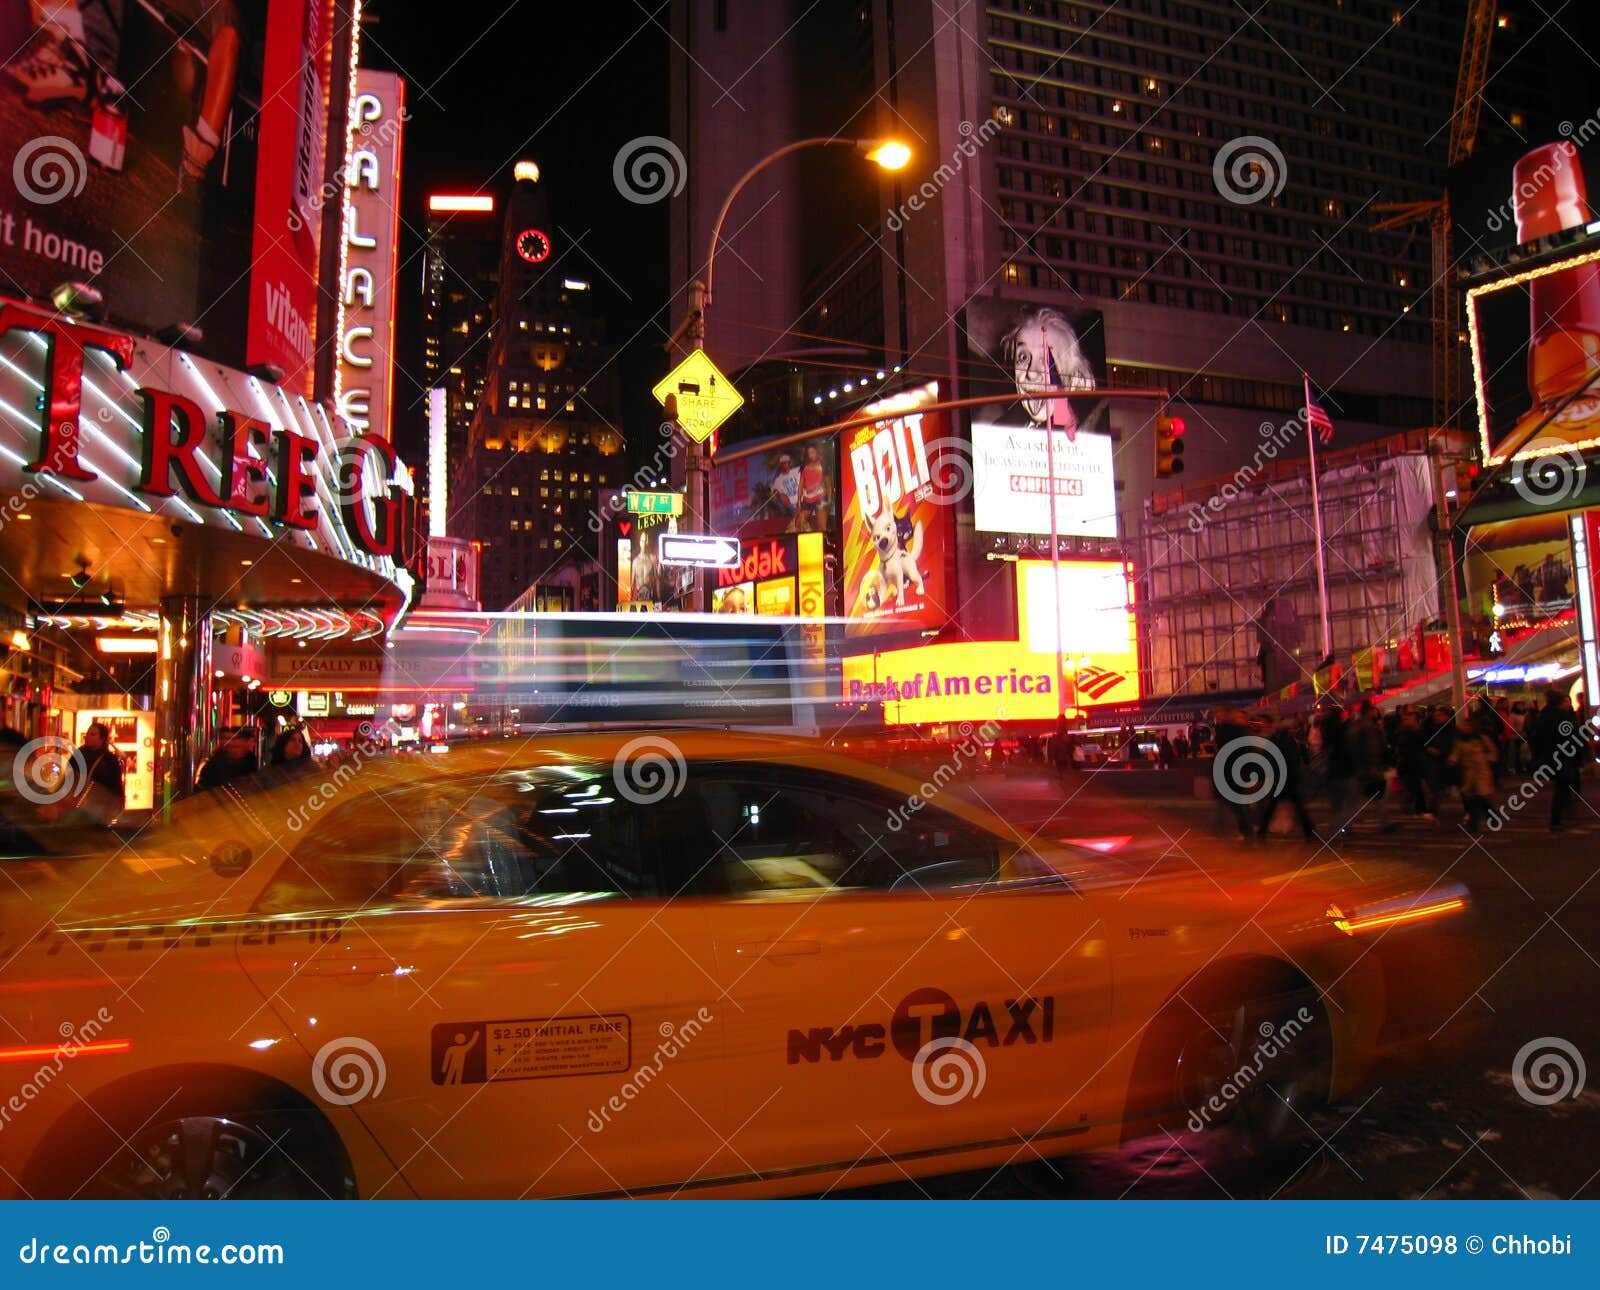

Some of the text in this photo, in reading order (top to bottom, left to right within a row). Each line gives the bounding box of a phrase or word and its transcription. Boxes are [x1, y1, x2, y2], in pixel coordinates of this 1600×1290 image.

[24, 219, 104, 275] home
[341, 93, 382, 430] PALACE
[0, 297, 320, 531] TREE
[681, 397, 717, 409] SHARE
[850, 412, 931, 522] BOLT
[1010, 475, 1084, 496] CONFIENCE
[629, 494, 671, 512] W 47 ST
[718, 540, 787, 587] Kodak
[291, 659, 355, 672] LEGALLY
[901, 673, 924, 700] of
[925, 668, 1051, 698] America
[493, 1021, 622, 1040] $2.50 INITIAL FARE
[787, 995, 1055, 1065] NYC TAXI
